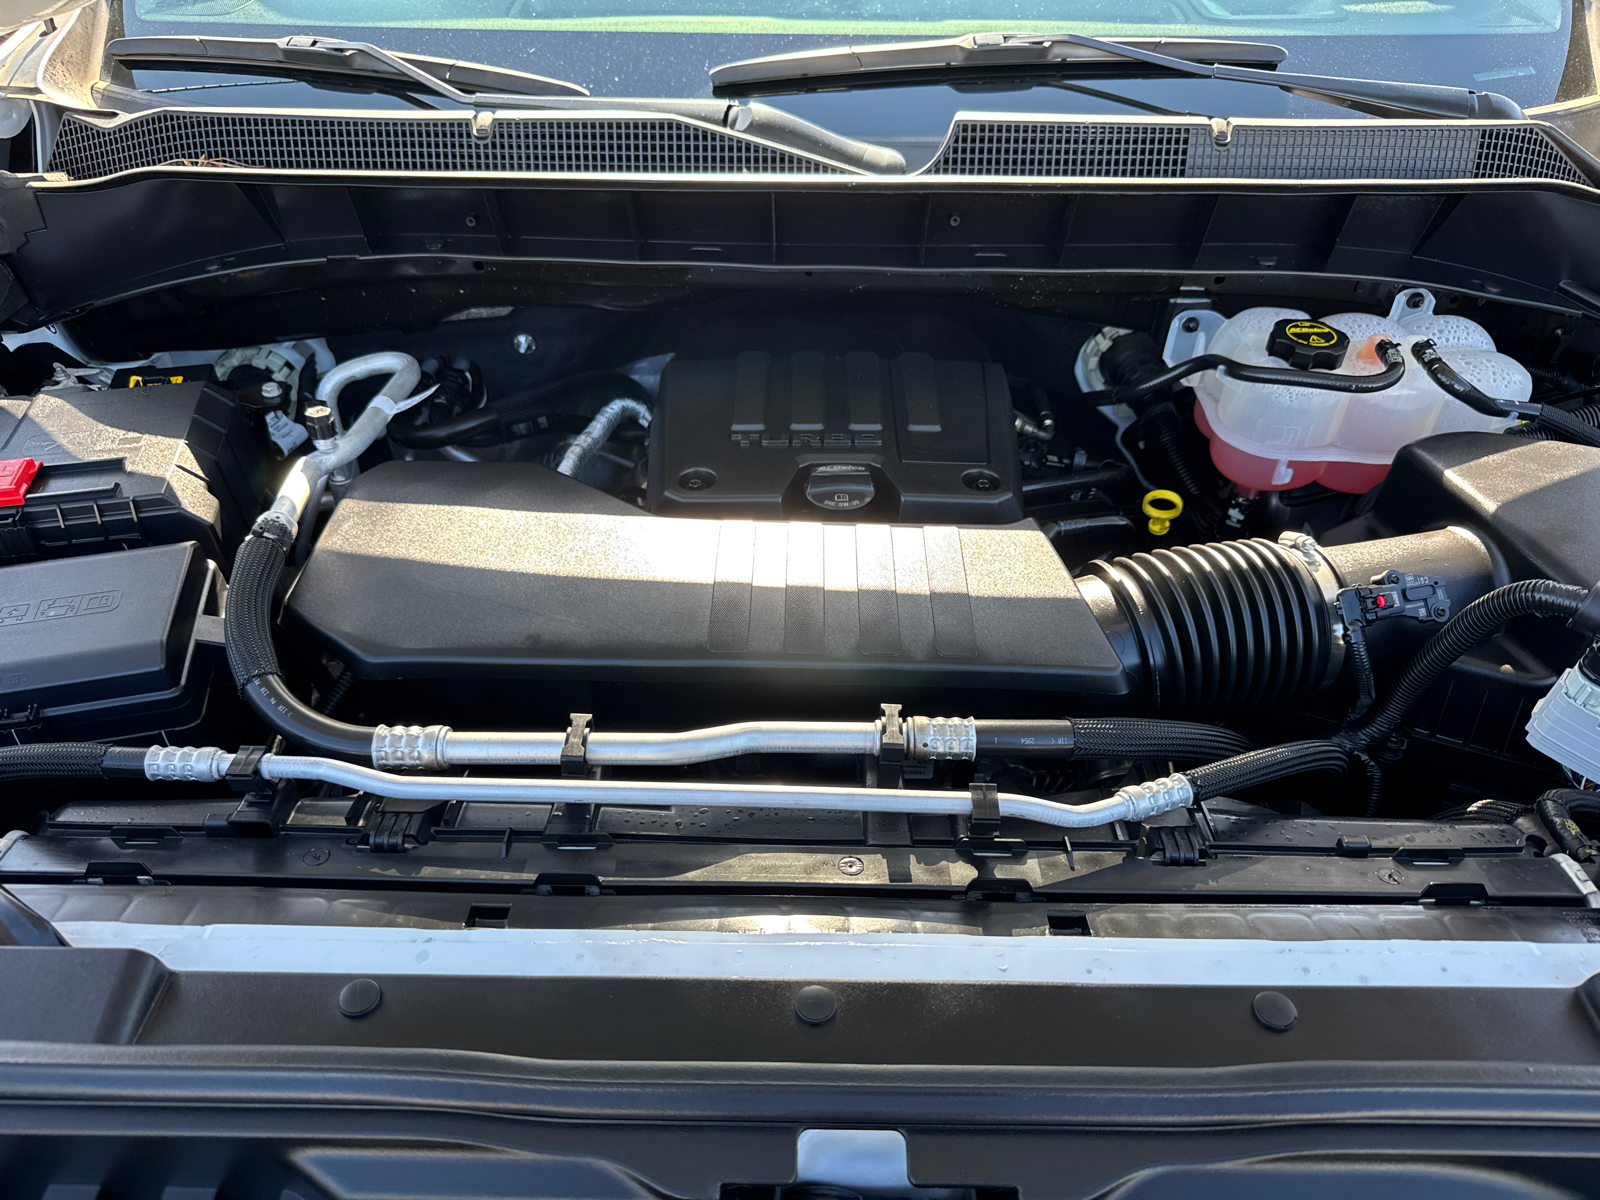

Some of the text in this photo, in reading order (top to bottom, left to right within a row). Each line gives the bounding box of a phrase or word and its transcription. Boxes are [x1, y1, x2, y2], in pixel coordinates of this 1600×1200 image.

[731, 433, 883, 446] TURBO
[815, 465, 866, 473] ACDelco
[823, 499, 837, 507] SAE
